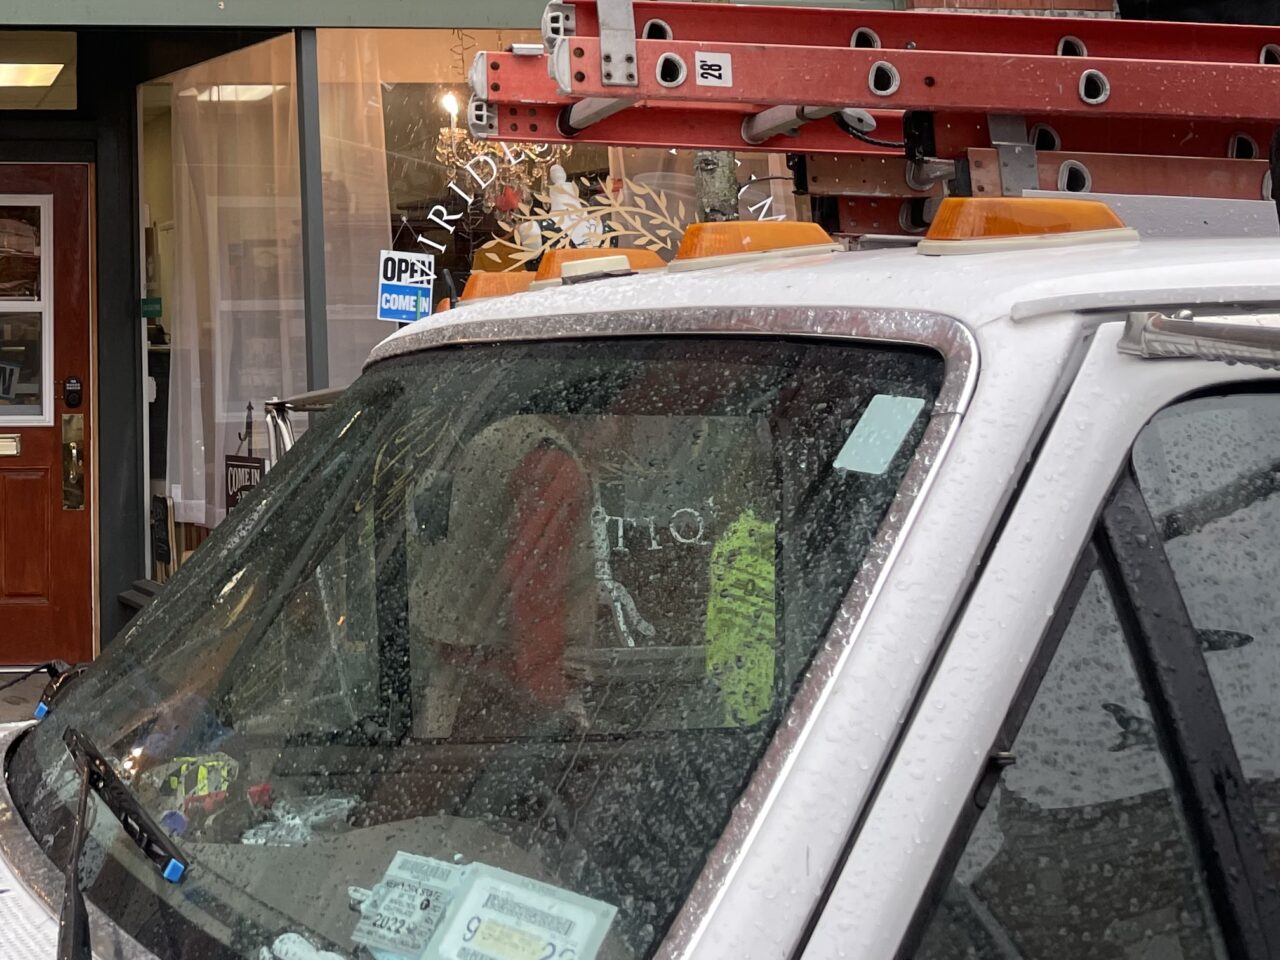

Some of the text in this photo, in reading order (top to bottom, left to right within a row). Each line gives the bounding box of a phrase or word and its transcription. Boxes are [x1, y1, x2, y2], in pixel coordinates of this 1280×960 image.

[382, 257, 432, 285] OPEN
[382, 292, 430, 313] COME IN
[228, 466, 261, 496] COME IN
[462, 916, 482, 943] 9
